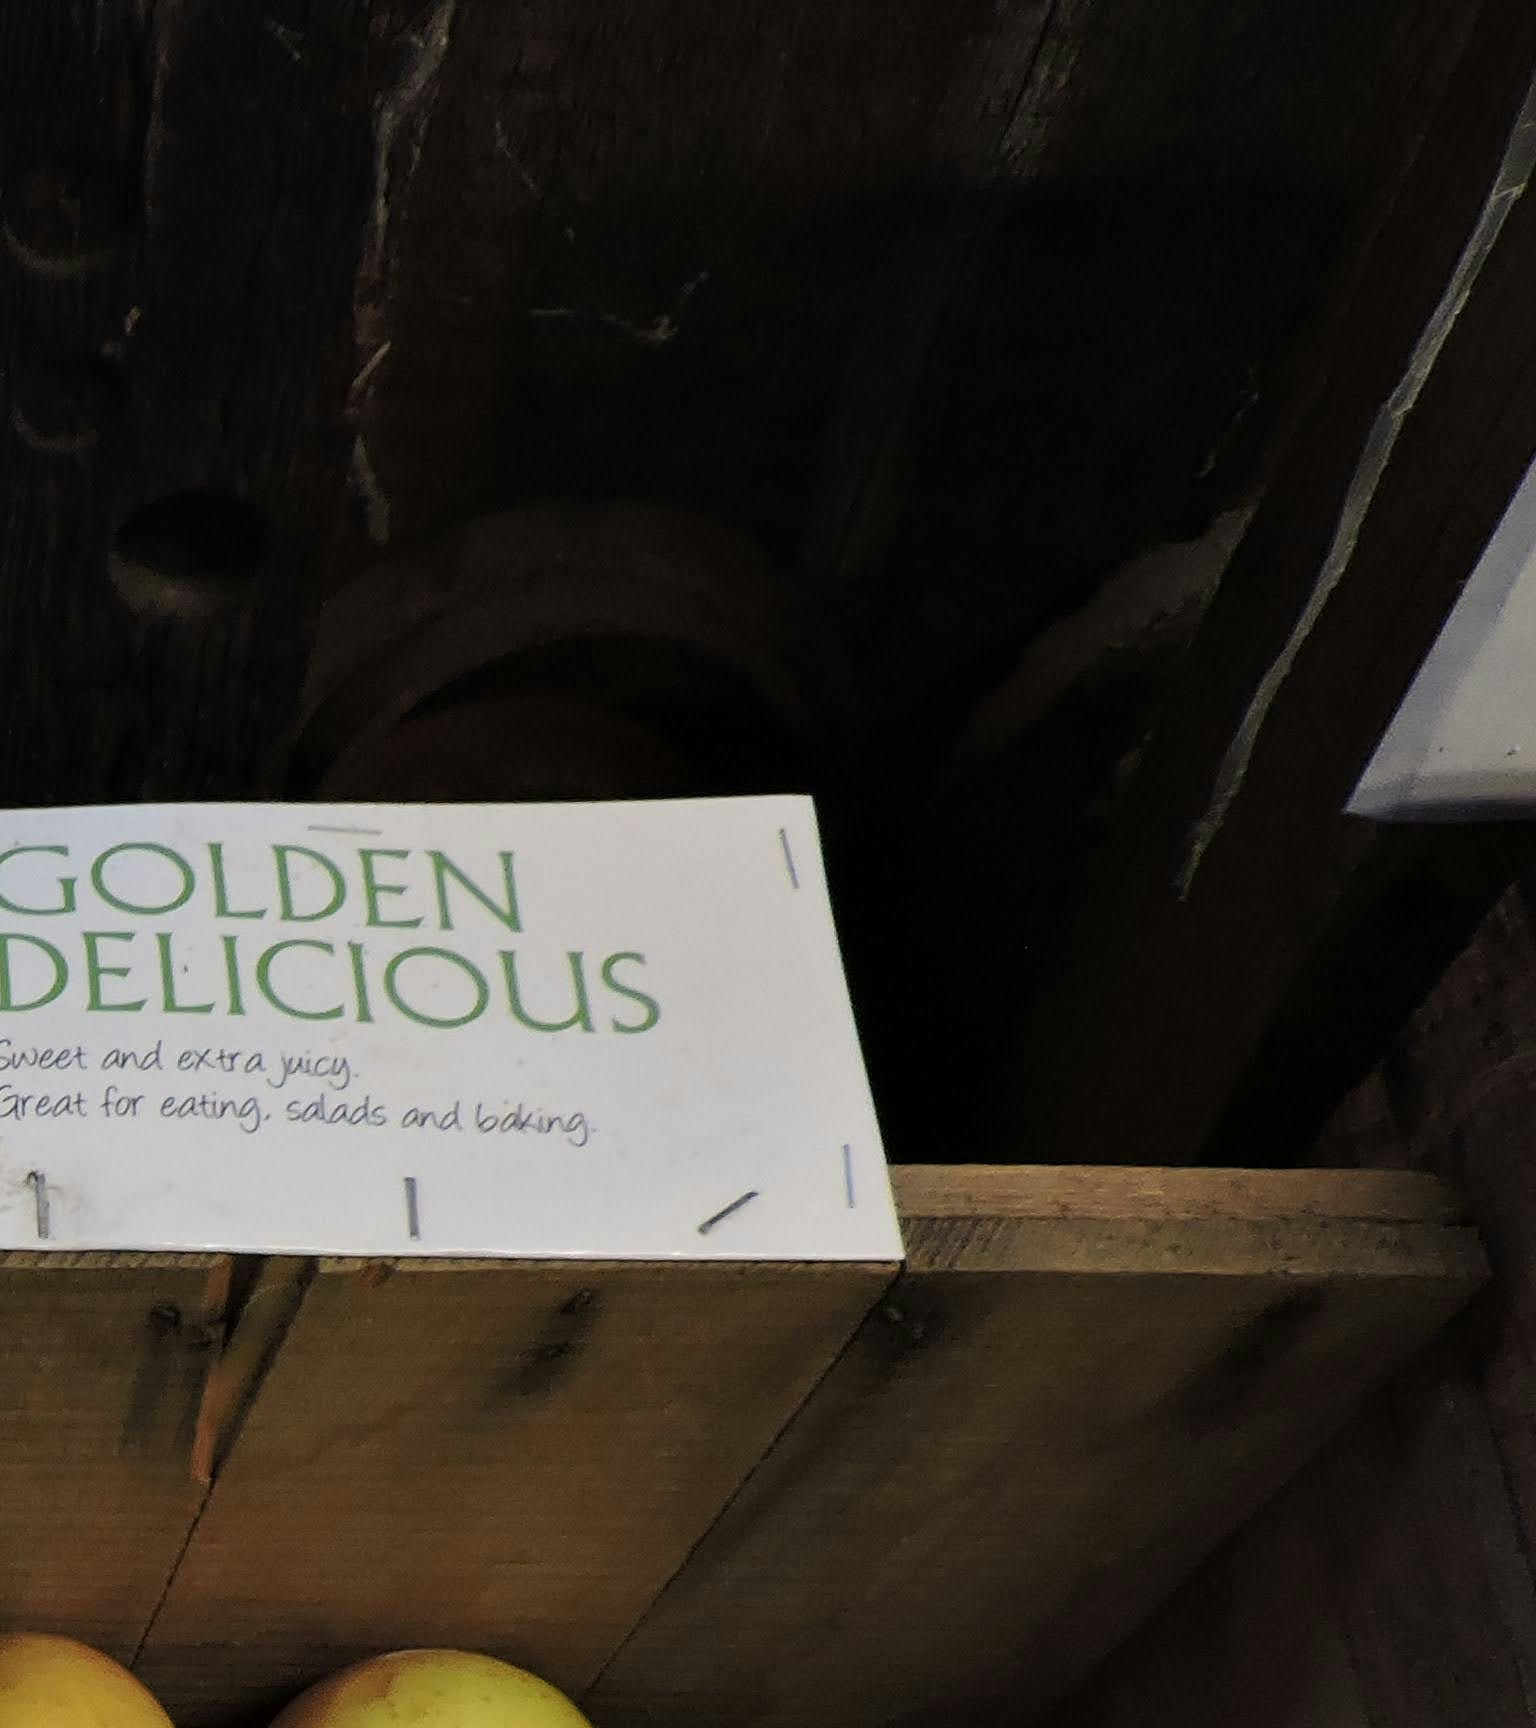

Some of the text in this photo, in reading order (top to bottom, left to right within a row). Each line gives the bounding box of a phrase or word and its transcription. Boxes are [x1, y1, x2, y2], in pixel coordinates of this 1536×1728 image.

[100, 1039, 163, 1072] and
[177, 1047, 268, 1073] extra
[266, 1050, 360, 1091] juicy.
[100, 1085, 145, 1118] for
[286, 1093, 388, 1127] salads
[400, 1100, 463, 1132] and
[476, 1101, 598, 1148] baking.
